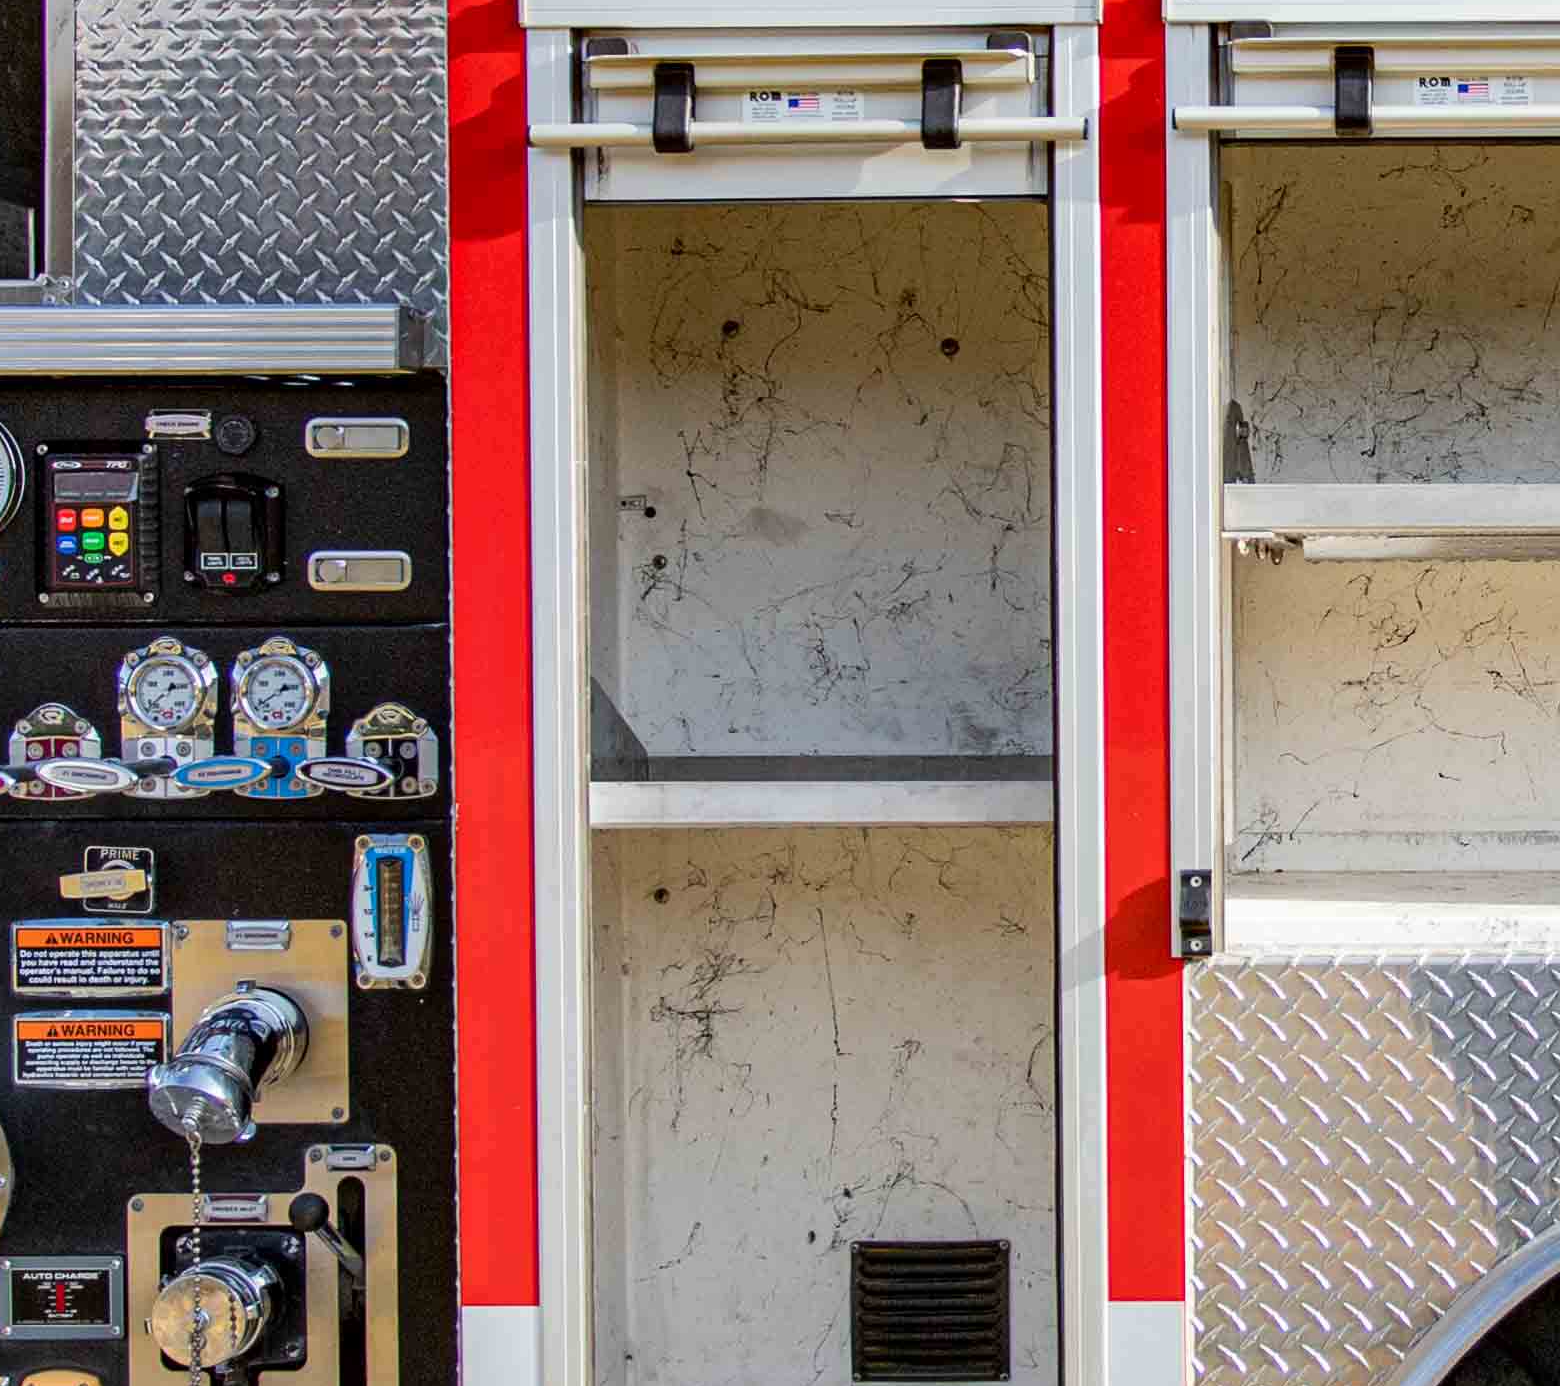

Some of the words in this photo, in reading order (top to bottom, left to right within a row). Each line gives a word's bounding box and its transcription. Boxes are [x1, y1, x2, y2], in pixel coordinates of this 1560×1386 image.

[100, 848, 140, 861] PRIME
[61, 931, 134, 944] WARNING
[20, 950, 32, 958] Do
[33, 950, 48, 958] not
[49, 950, 80, 958] operate
[82, 950, 96, 958] this
[99, 950, 139, 958] apparatus
[141, 950, 160, 958] until
[21, 959, 37, 967] you
[38, 959, 58, 967] have
[60, 959, 82, 967] read
[84, 959, 96, 967] and
[97, 959, 144, 967] understand
[145, 959, 159, 967] the
[97, 967, 125, 975] Failure
[127, 967, 135, 975] to
[137, 967, 149, 975] do
[150, 967, 160, 975] so
[28, 976, 52, 985] could
[54, 976, 77, 985] result
[79, 976, 86, 985] in
[88, 976, 112, 985] death
[113, 976, 122, 985] or
[61, 1024, 135, 1037] WARNING
